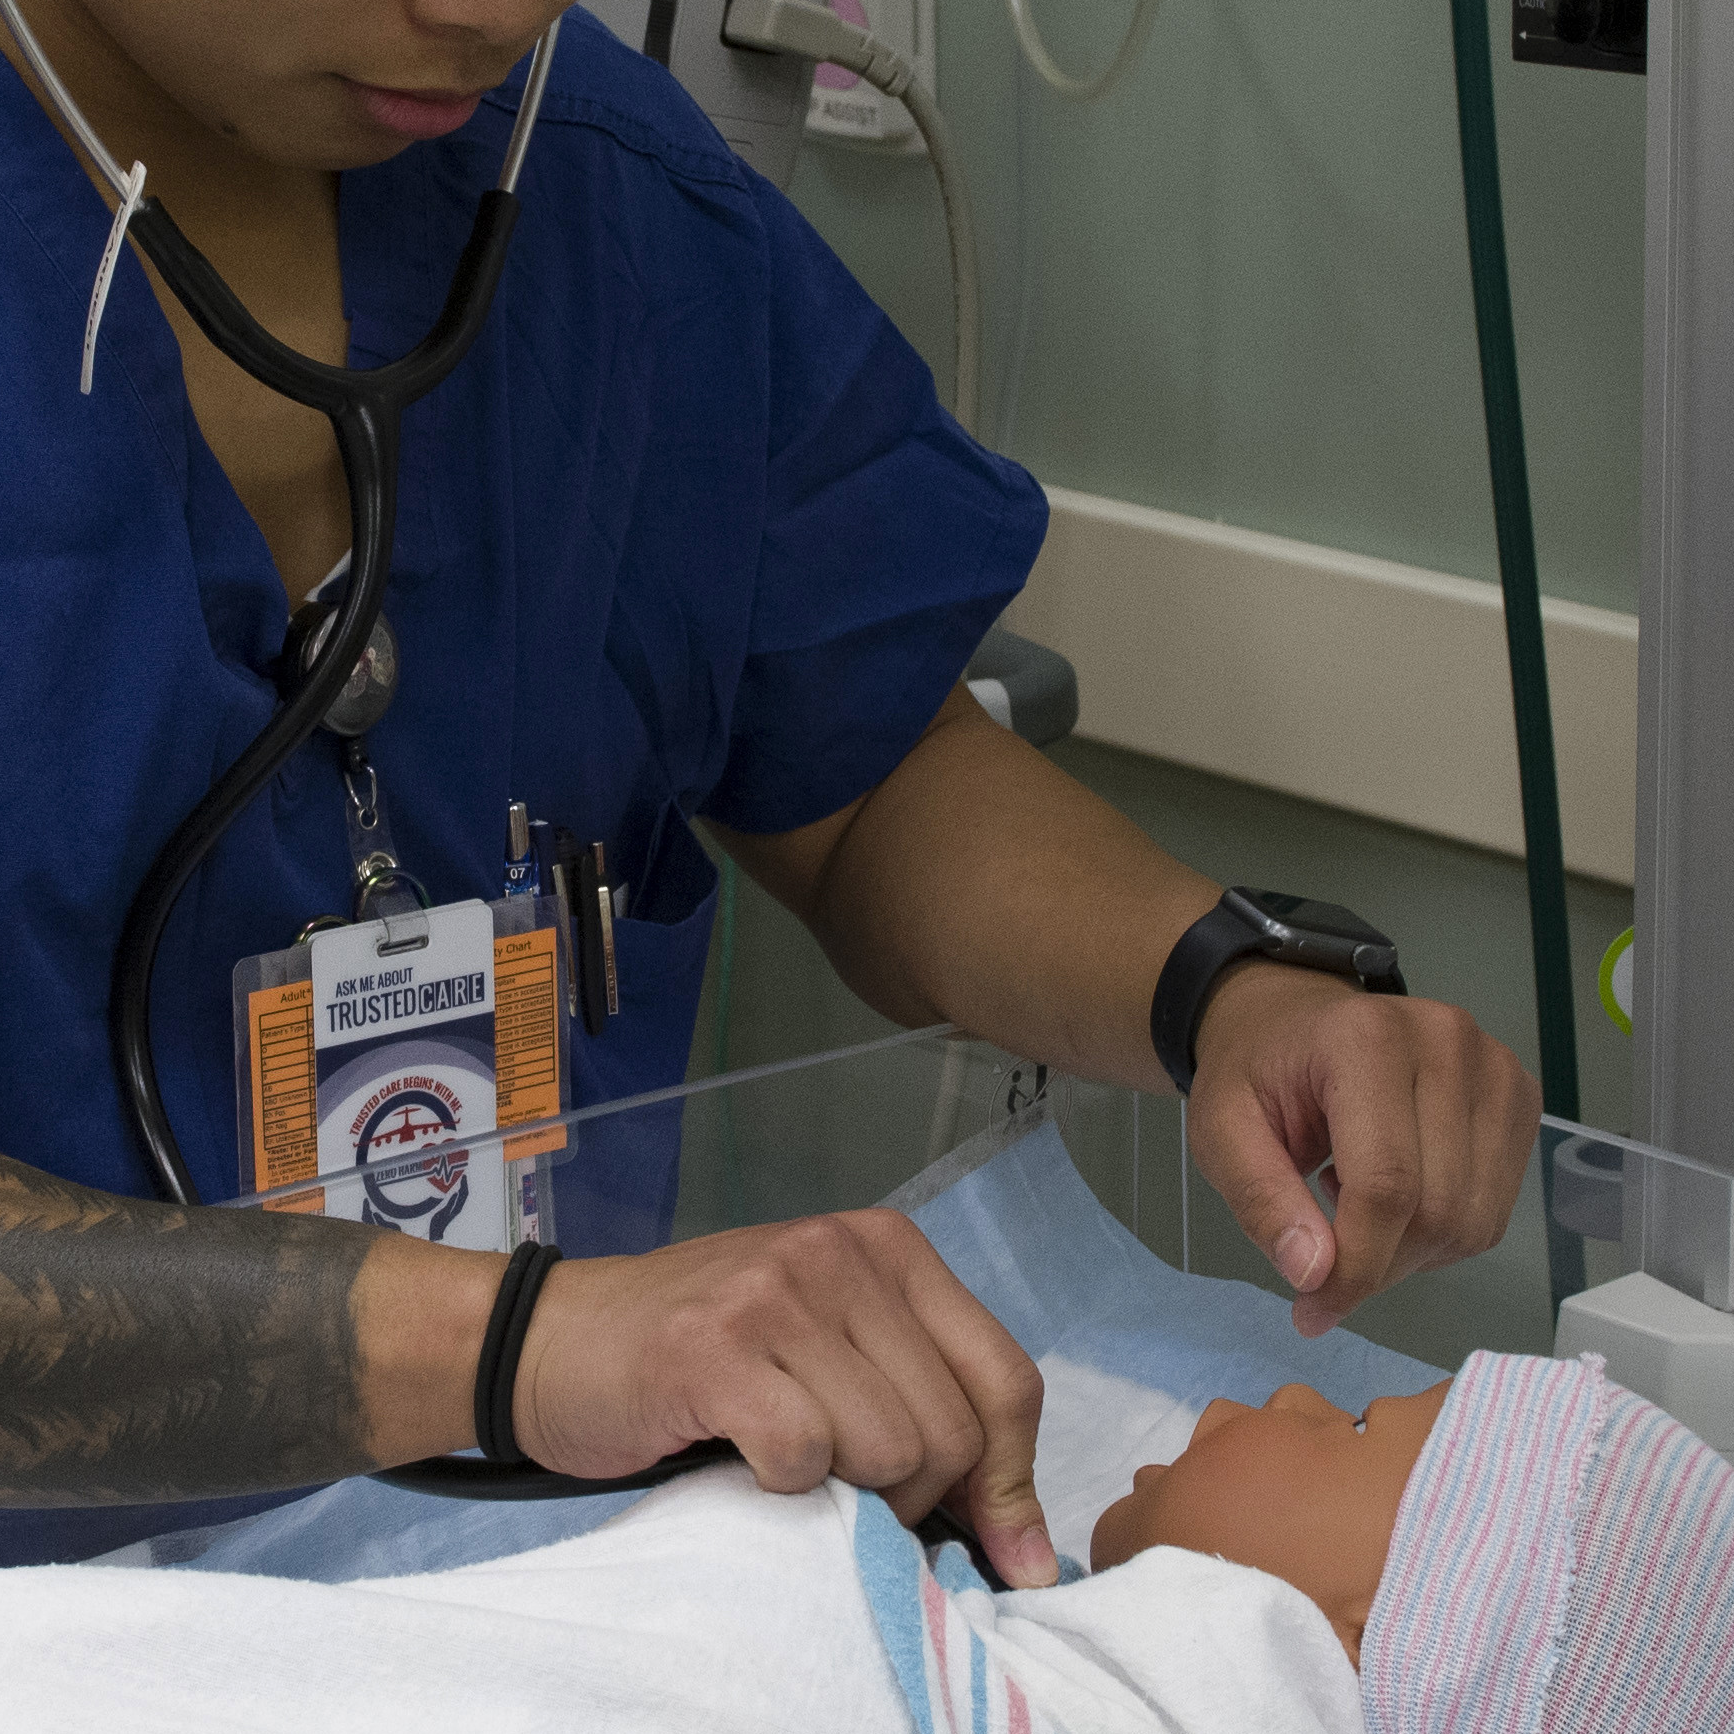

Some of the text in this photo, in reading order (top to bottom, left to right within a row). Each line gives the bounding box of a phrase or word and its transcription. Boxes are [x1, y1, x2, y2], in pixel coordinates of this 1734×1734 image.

[510, 867, 526, 880] 07
[506, 940, 532, 955] Chart
[335, 966, 414, 999] ASK ME ABOUT
[349, 1075, 464, 1136] TRUSTED CARE BEGINS WITH ME
